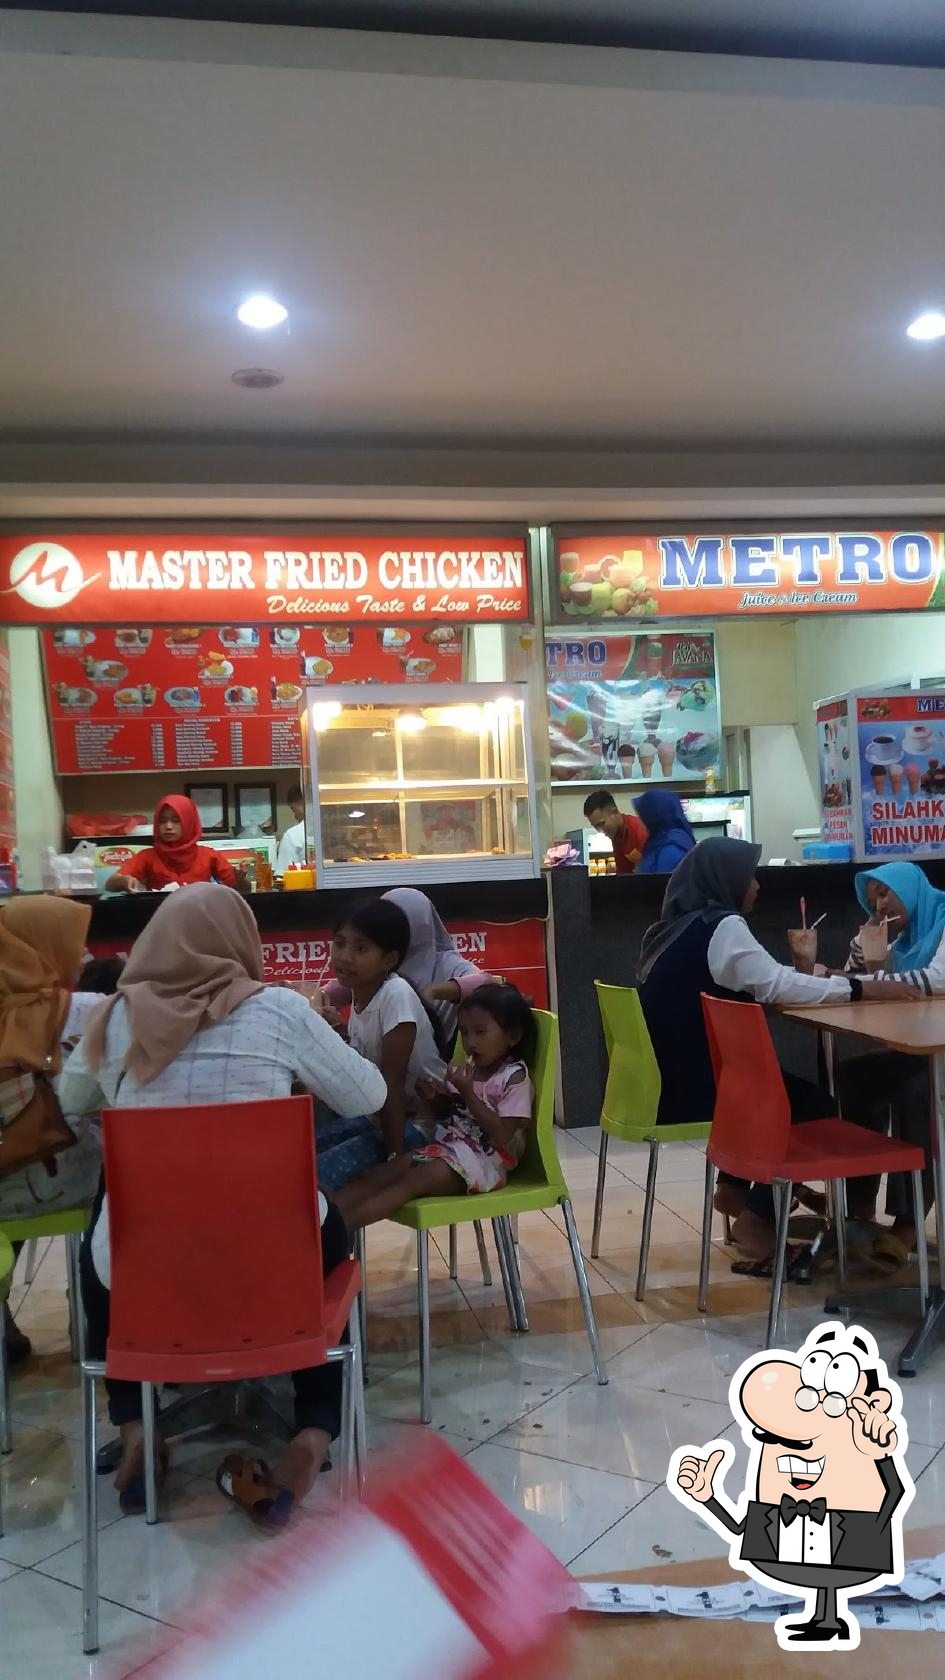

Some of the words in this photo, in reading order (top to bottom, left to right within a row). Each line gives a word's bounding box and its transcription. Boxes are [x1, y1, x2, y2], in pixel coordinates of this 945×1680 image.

[108, 550, 255, 590] MASTER
[265, 550, 368, 590] FRIED
[378, 550, 523, 590] CHICKEN
[658, 532, 936, 590] METRO
[266, 594, 351, 615] Delicious
[355, 595, 406, 614] Taste
[412, 595, 426, 612] &
[431, 595, 470, 613] Low
[476, 594, 522, 613] Price
[738, 592, 776, 609] Juice
[790, 592, 810, 606] Ice
[813, 590, 857, 605] Cream
[261, 940, 333, 964] FRIE
[451, 932, 487, 953] EN
